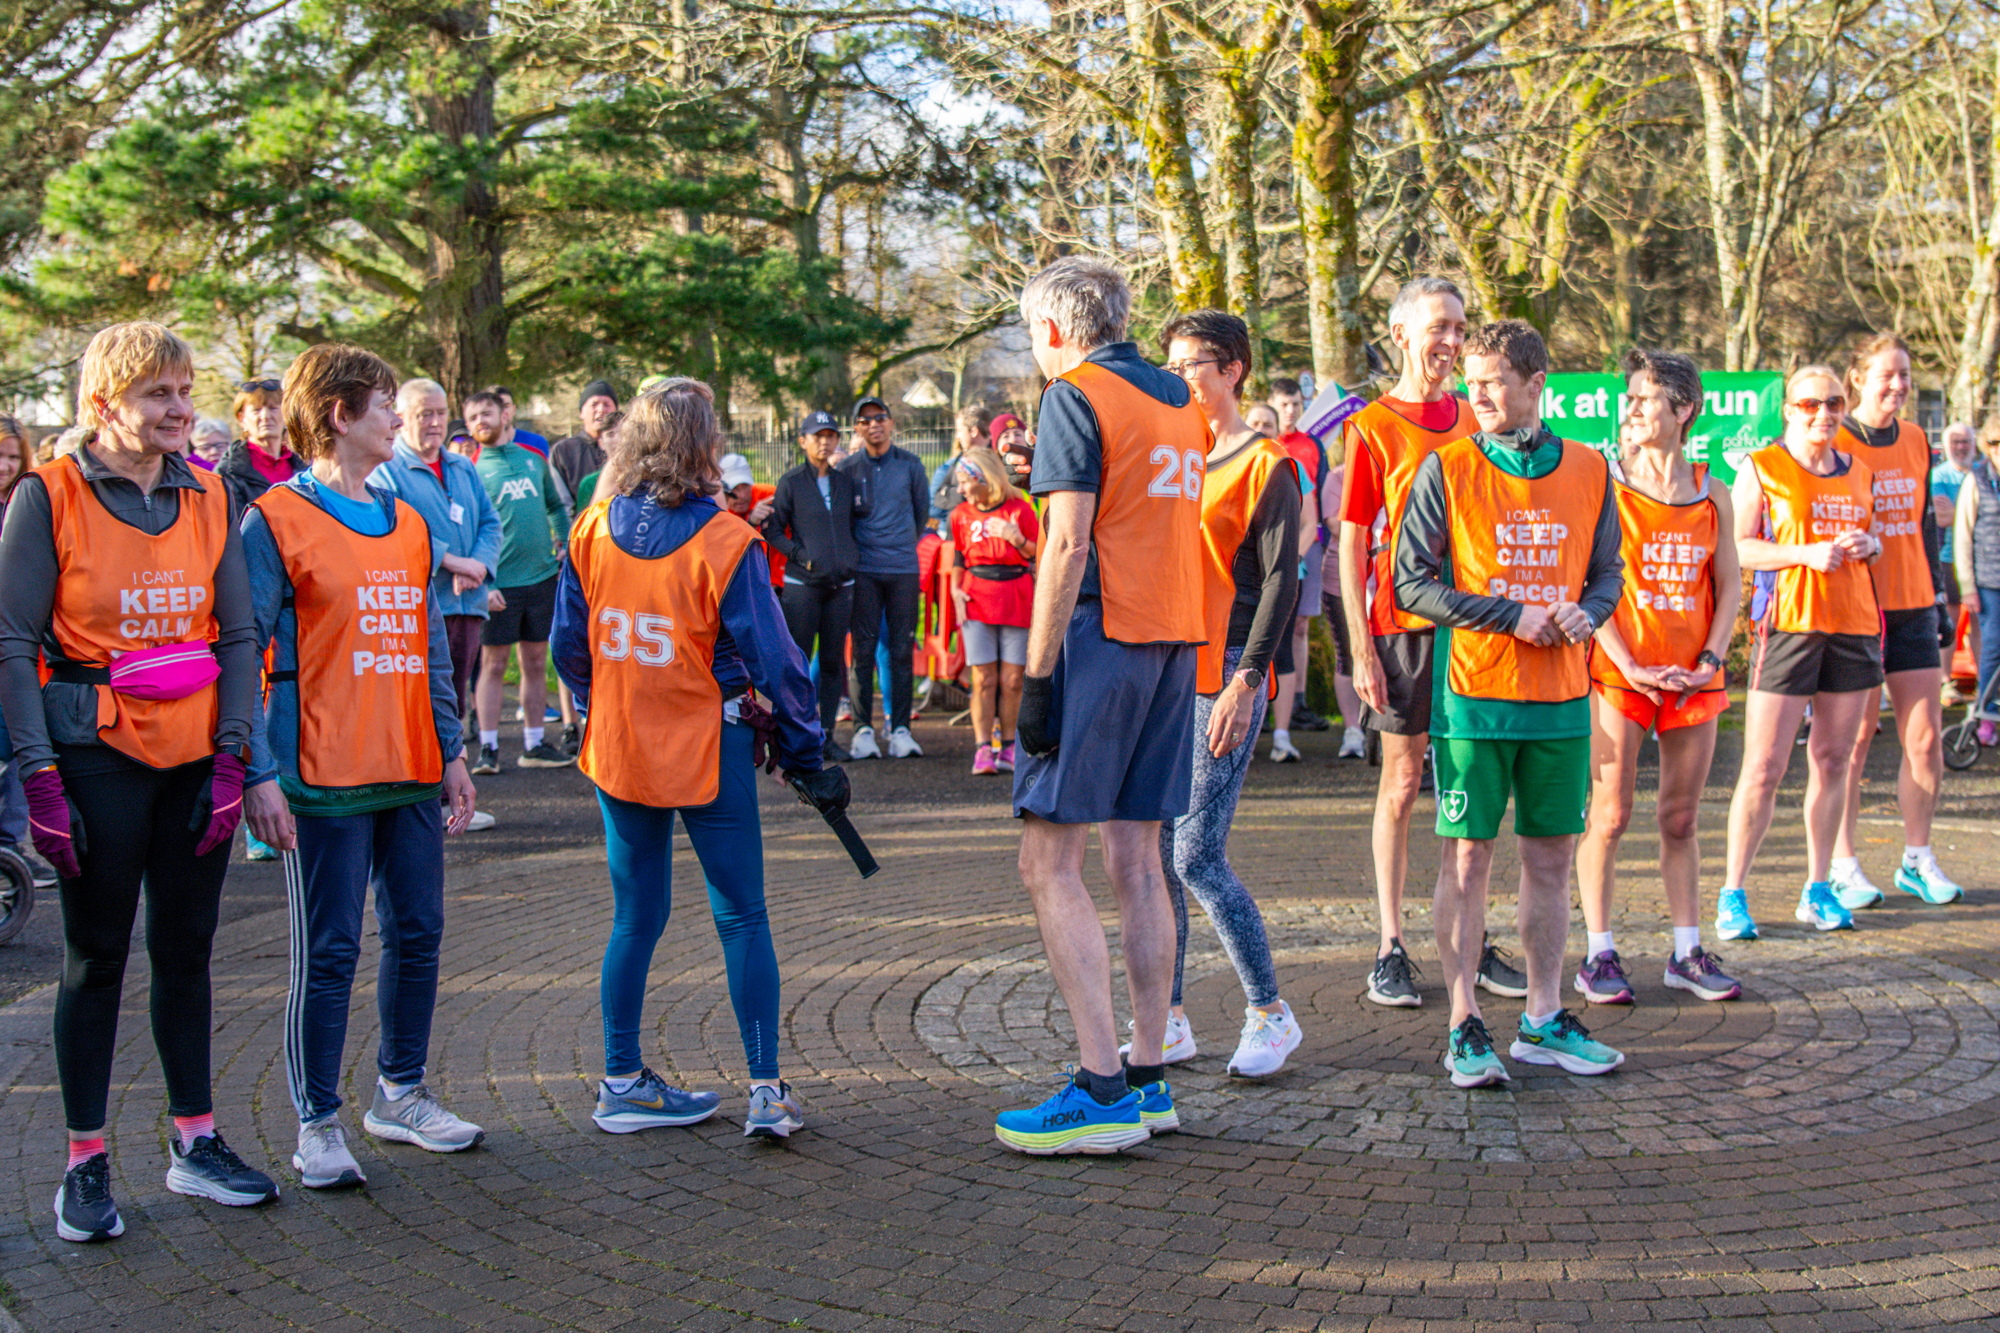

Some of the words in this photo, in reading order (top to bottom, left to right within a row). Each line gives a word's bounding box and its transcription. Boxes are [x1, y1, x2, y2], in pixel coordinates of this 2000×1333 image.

[1574, 387, 1609, 418] at
[1147, 444, 1204, 502] 26
[495, 477, 538, 504] AXA
[1872, 478, 1917, 497] KEEP
[1811, 501, 1866, 522] KEEP
[1874, 495, 1915, 512] CALM
[1513, 508, 1551, 522] CAN'T
[1495, 523, 1568, 545] KEEP
[1658, 531, 1692, 543] CAN'T
[1875, 521, 1917, 537] Pace
[1496, 547, 1558, 567] CALM
[1642, 542, 1706, 564] KEEP
[133, 572, 137, 585] I
[142, 569, 184, 585] CAN'T
[366, 570, 371, 582] I
[372, 570, 407, 582] CAN'T
[1515, 569, 1532, 581] I'M
[1535, 569, 1544, 581] A
[1641, 564, 1697, 582] CALM
[357, 586, 423, 611] KEEP
[1489, 578, 1569, 602] Pacer
[1677, 583, 1686, 594] A
[120, 585, 206, 614] KEEP
[120, 616, 194, 638] CALM
[359, 614, 419, 635] CALM
[382, 638, 398, 650] I'M
[400, 638, 408, 650] A
[599, 606, 675, 667] 35
[1042, 1109, 1086, 1128] HOKA
